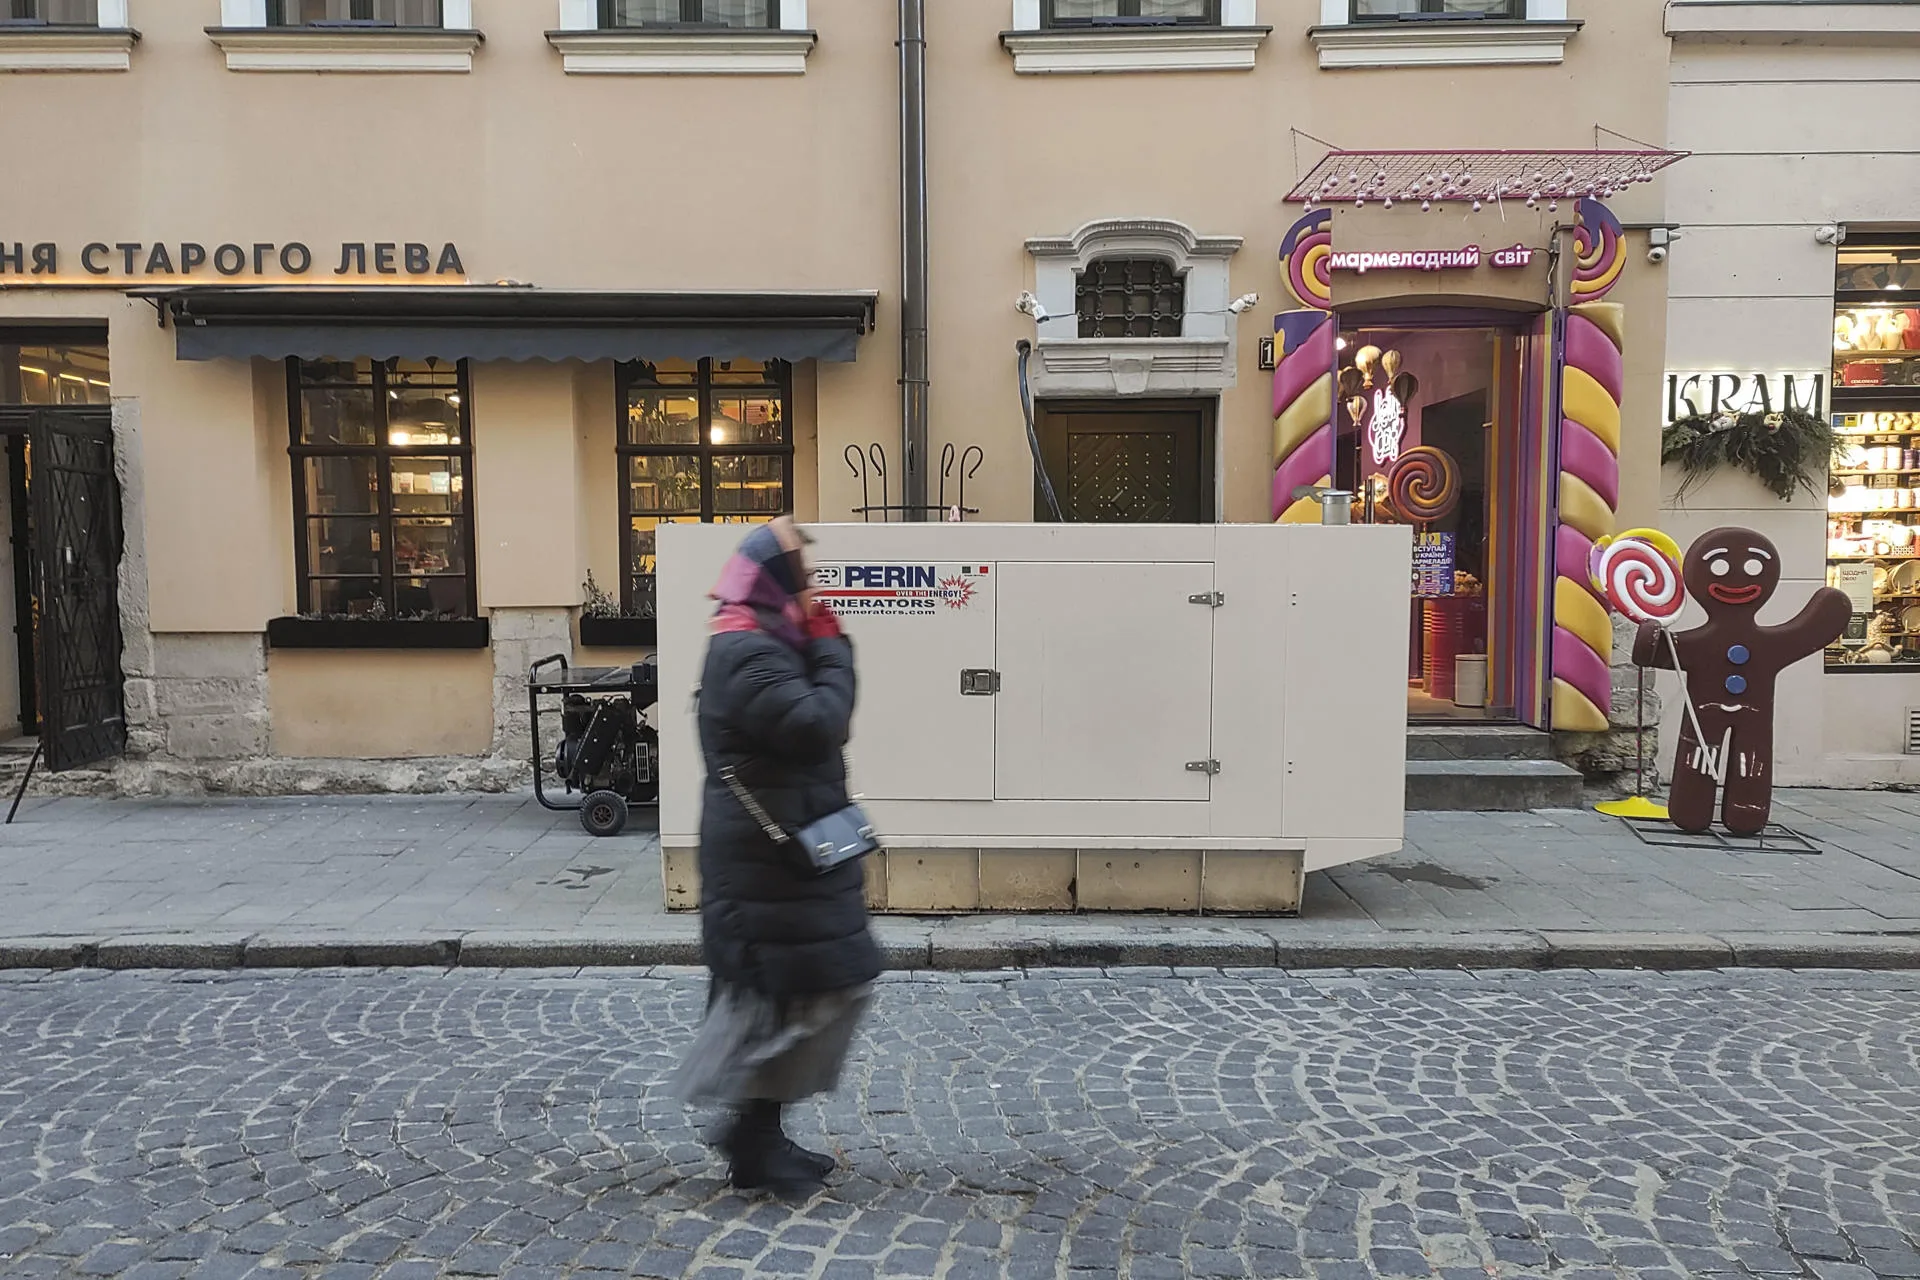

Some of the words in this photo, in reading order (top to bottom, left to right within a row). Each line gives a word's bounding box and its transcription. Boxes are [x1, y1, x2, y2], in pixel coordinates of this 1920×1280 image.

[81, 242, 312, 275] СТАРОГО
[334, 242, 465, 275] ЛЕВА
[1331, 247, 1479, 272] мармеладний
[1494, 245, 1532, 264] світ
[1667, 373, 1824, 422] KRAM
[845, 566, 935, 588] PERIN
[811, 599, 935, 608] ENERATORS
